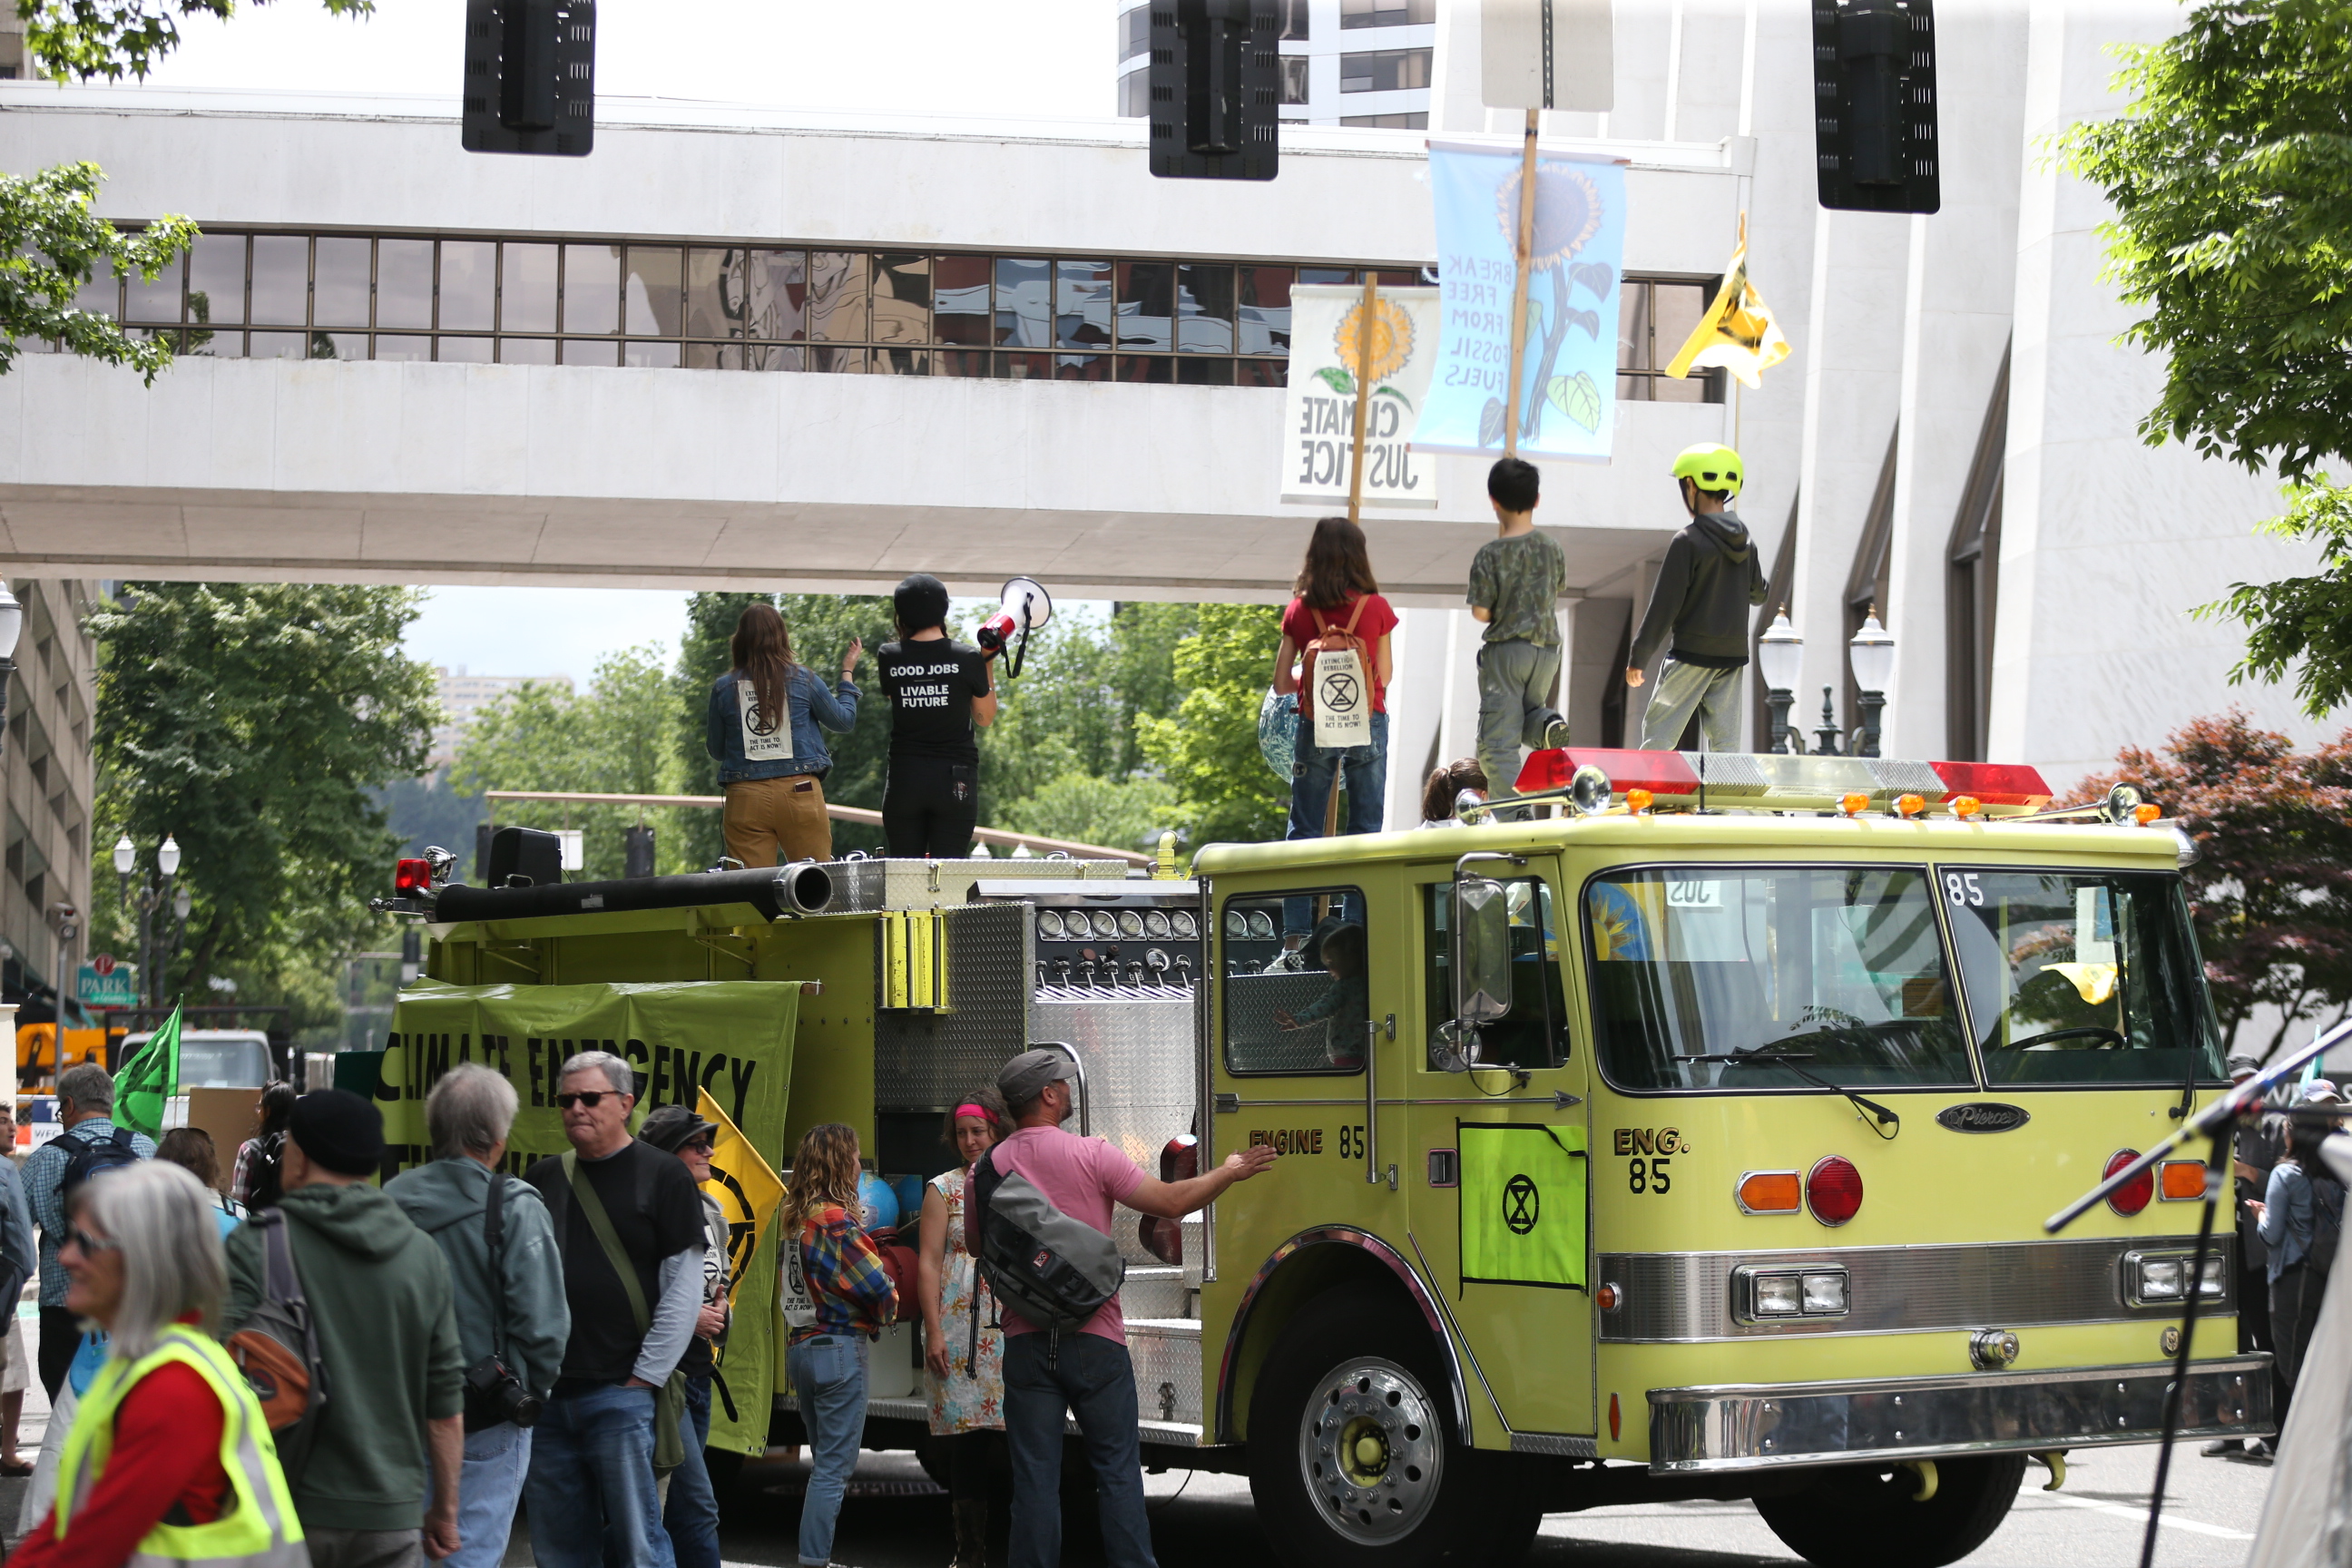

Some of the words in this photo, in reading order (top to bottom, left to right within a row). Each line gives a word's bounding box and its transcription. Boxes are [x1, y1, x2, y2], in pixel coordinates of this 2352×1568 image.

[889, 665, 925, 677] GOOD
[927, 663, 959, 675] JOBS
[1321, 657, 1355, 665] EXTINCTION
[900, 684, 949, 697] LIVABLE
[902, 696, 949, 708] FUTURE
[1344, 720, 1361, 729] NOW!
[1946, 873, 1984, 906] 85
[80, 977, 127, 995] PARK
[1956, 1106, 2011, 1128] Pierce
[1250, 1129, 1323, 1156] ENGINE
[1339, 1125, 1365, 1159] 85
[1613, 1126, 1690, 1156] ENG.
[1630, 1158, 1671, 1194] 85
